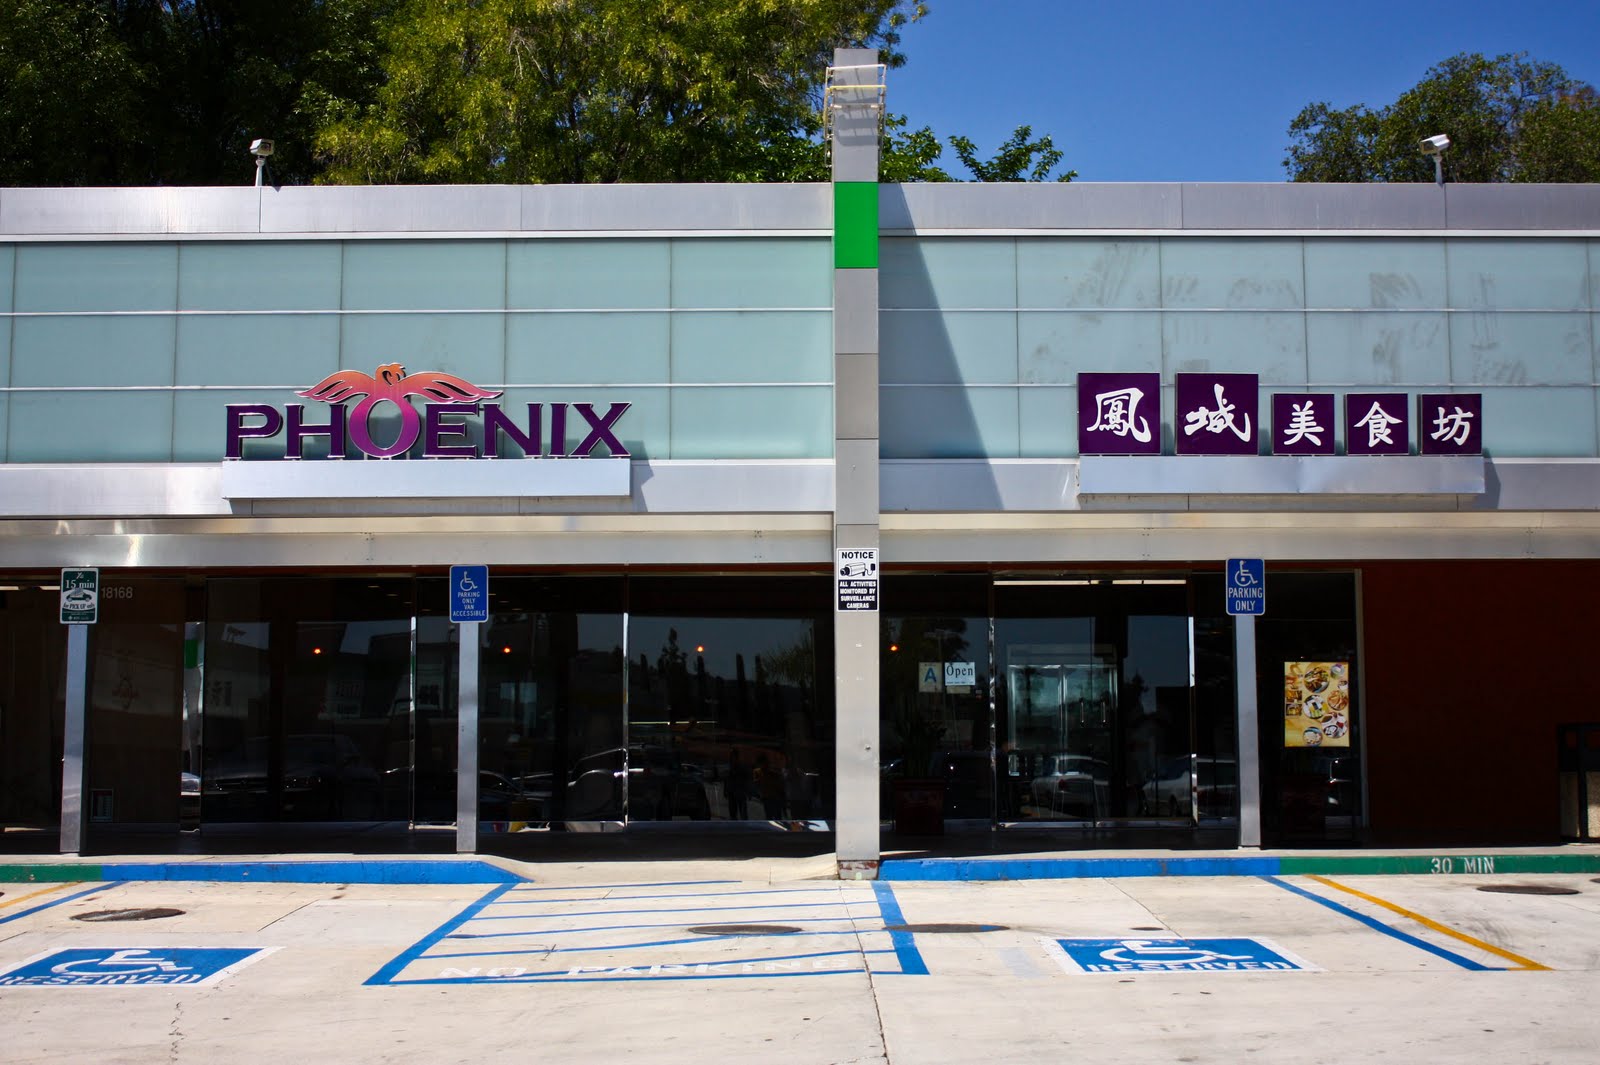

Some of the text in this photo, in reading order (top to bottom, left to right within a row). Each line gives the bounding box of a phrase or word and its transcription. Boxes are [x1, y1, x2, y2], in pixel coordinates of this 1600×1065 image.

[1086, 383, 1475, 447] 鳳城美食坊
[224, 396, 632, 459] PHOENIX
[841, 551, 874, 559] NOTICE
[65, 579, 95, 589] 15 min
[101, 586, 133, 599] 18168
[1228, 587, 1263, 599] PARKING
[1235, 600, 1256, 611] ONLY
[924, 667, 937, 682] A
[946, 664, 974, 678] Open
[1430, 856, 1495, 874] 30 MIN
[440, 958, 850, 978] NO PARKING
[1089, 962, 1294, 973] RESERVED
[0, 973, 201, 986] RESERVED
